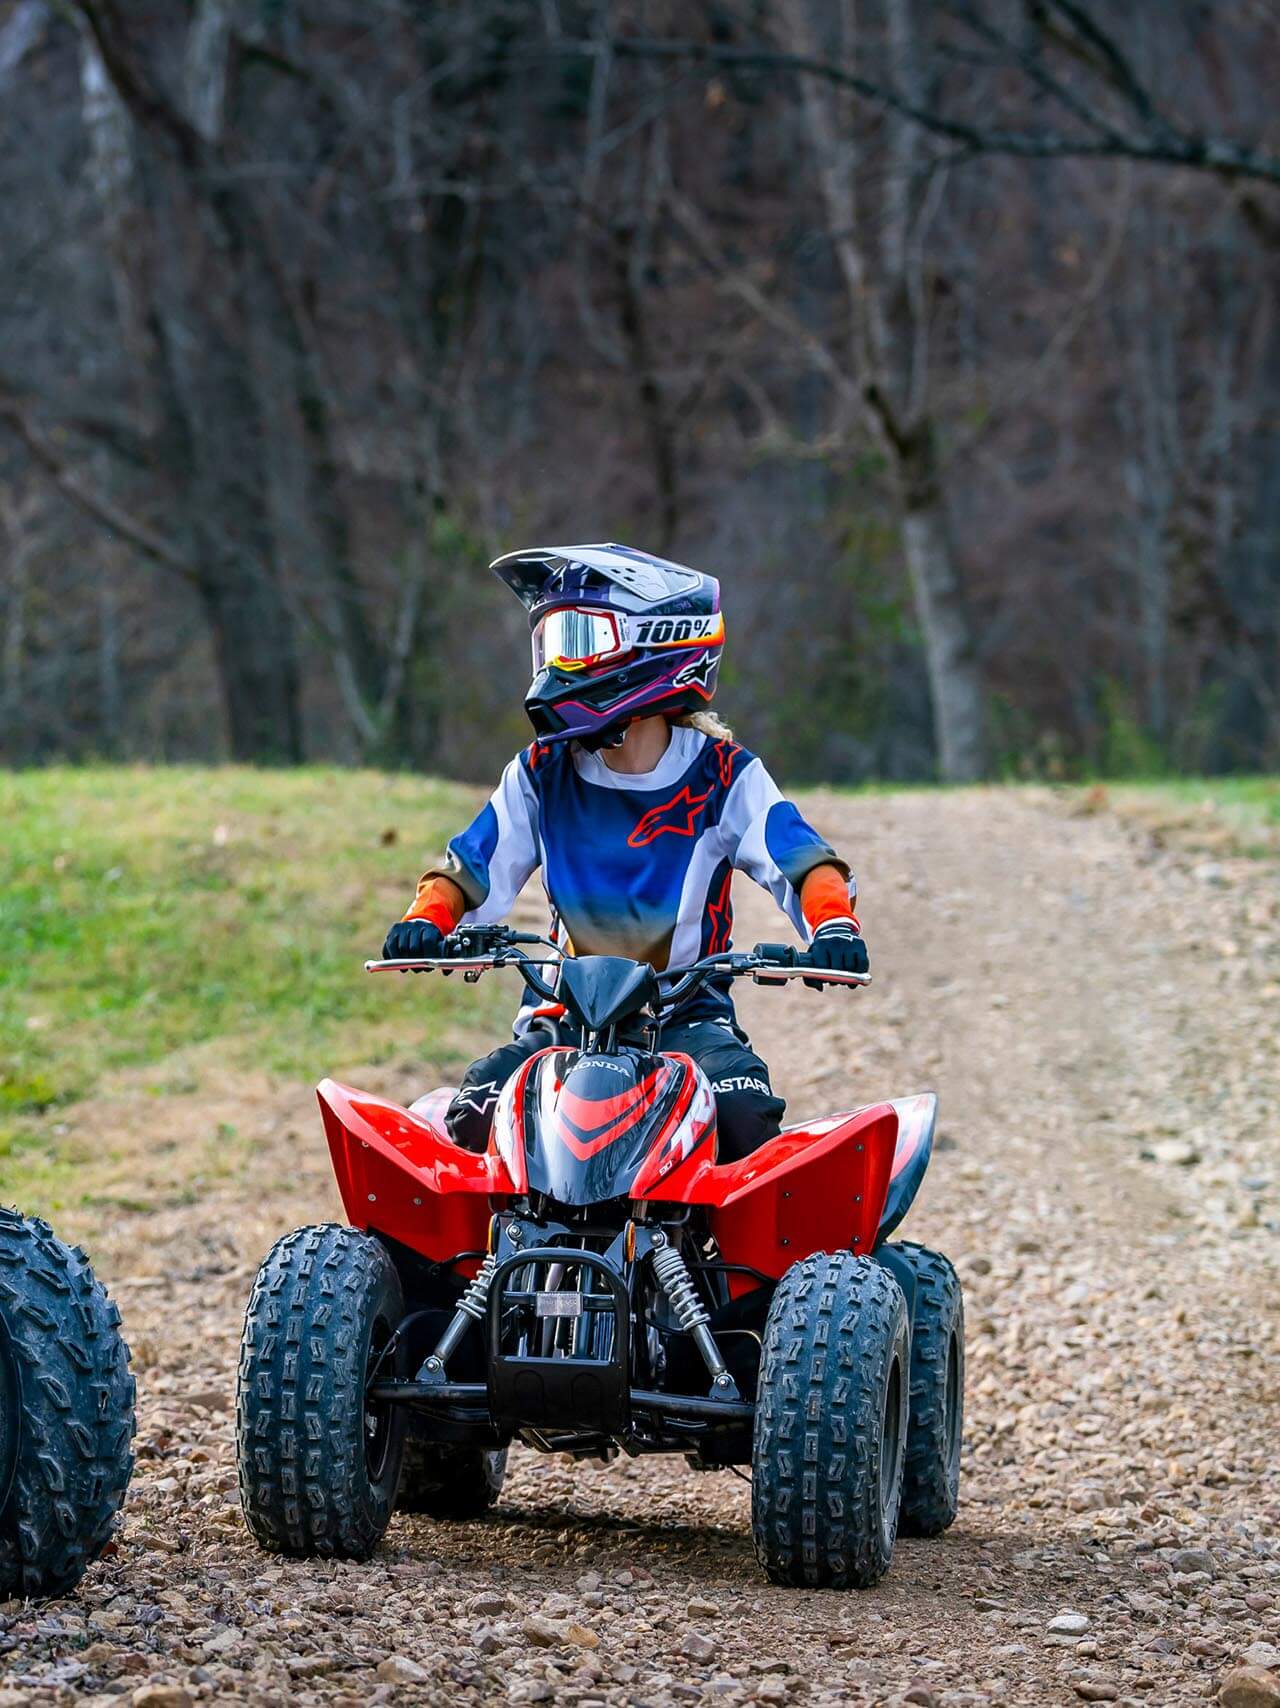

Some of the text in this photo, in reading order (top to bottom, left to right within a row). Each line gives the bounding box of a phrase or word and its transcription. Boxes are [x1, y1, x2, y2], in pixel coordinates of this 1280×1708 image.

[636, 619, 712, 643] 100%
[566, 1060, 631, 1078] HONDA
[711, 1076, 770, 1097] ASTARS
